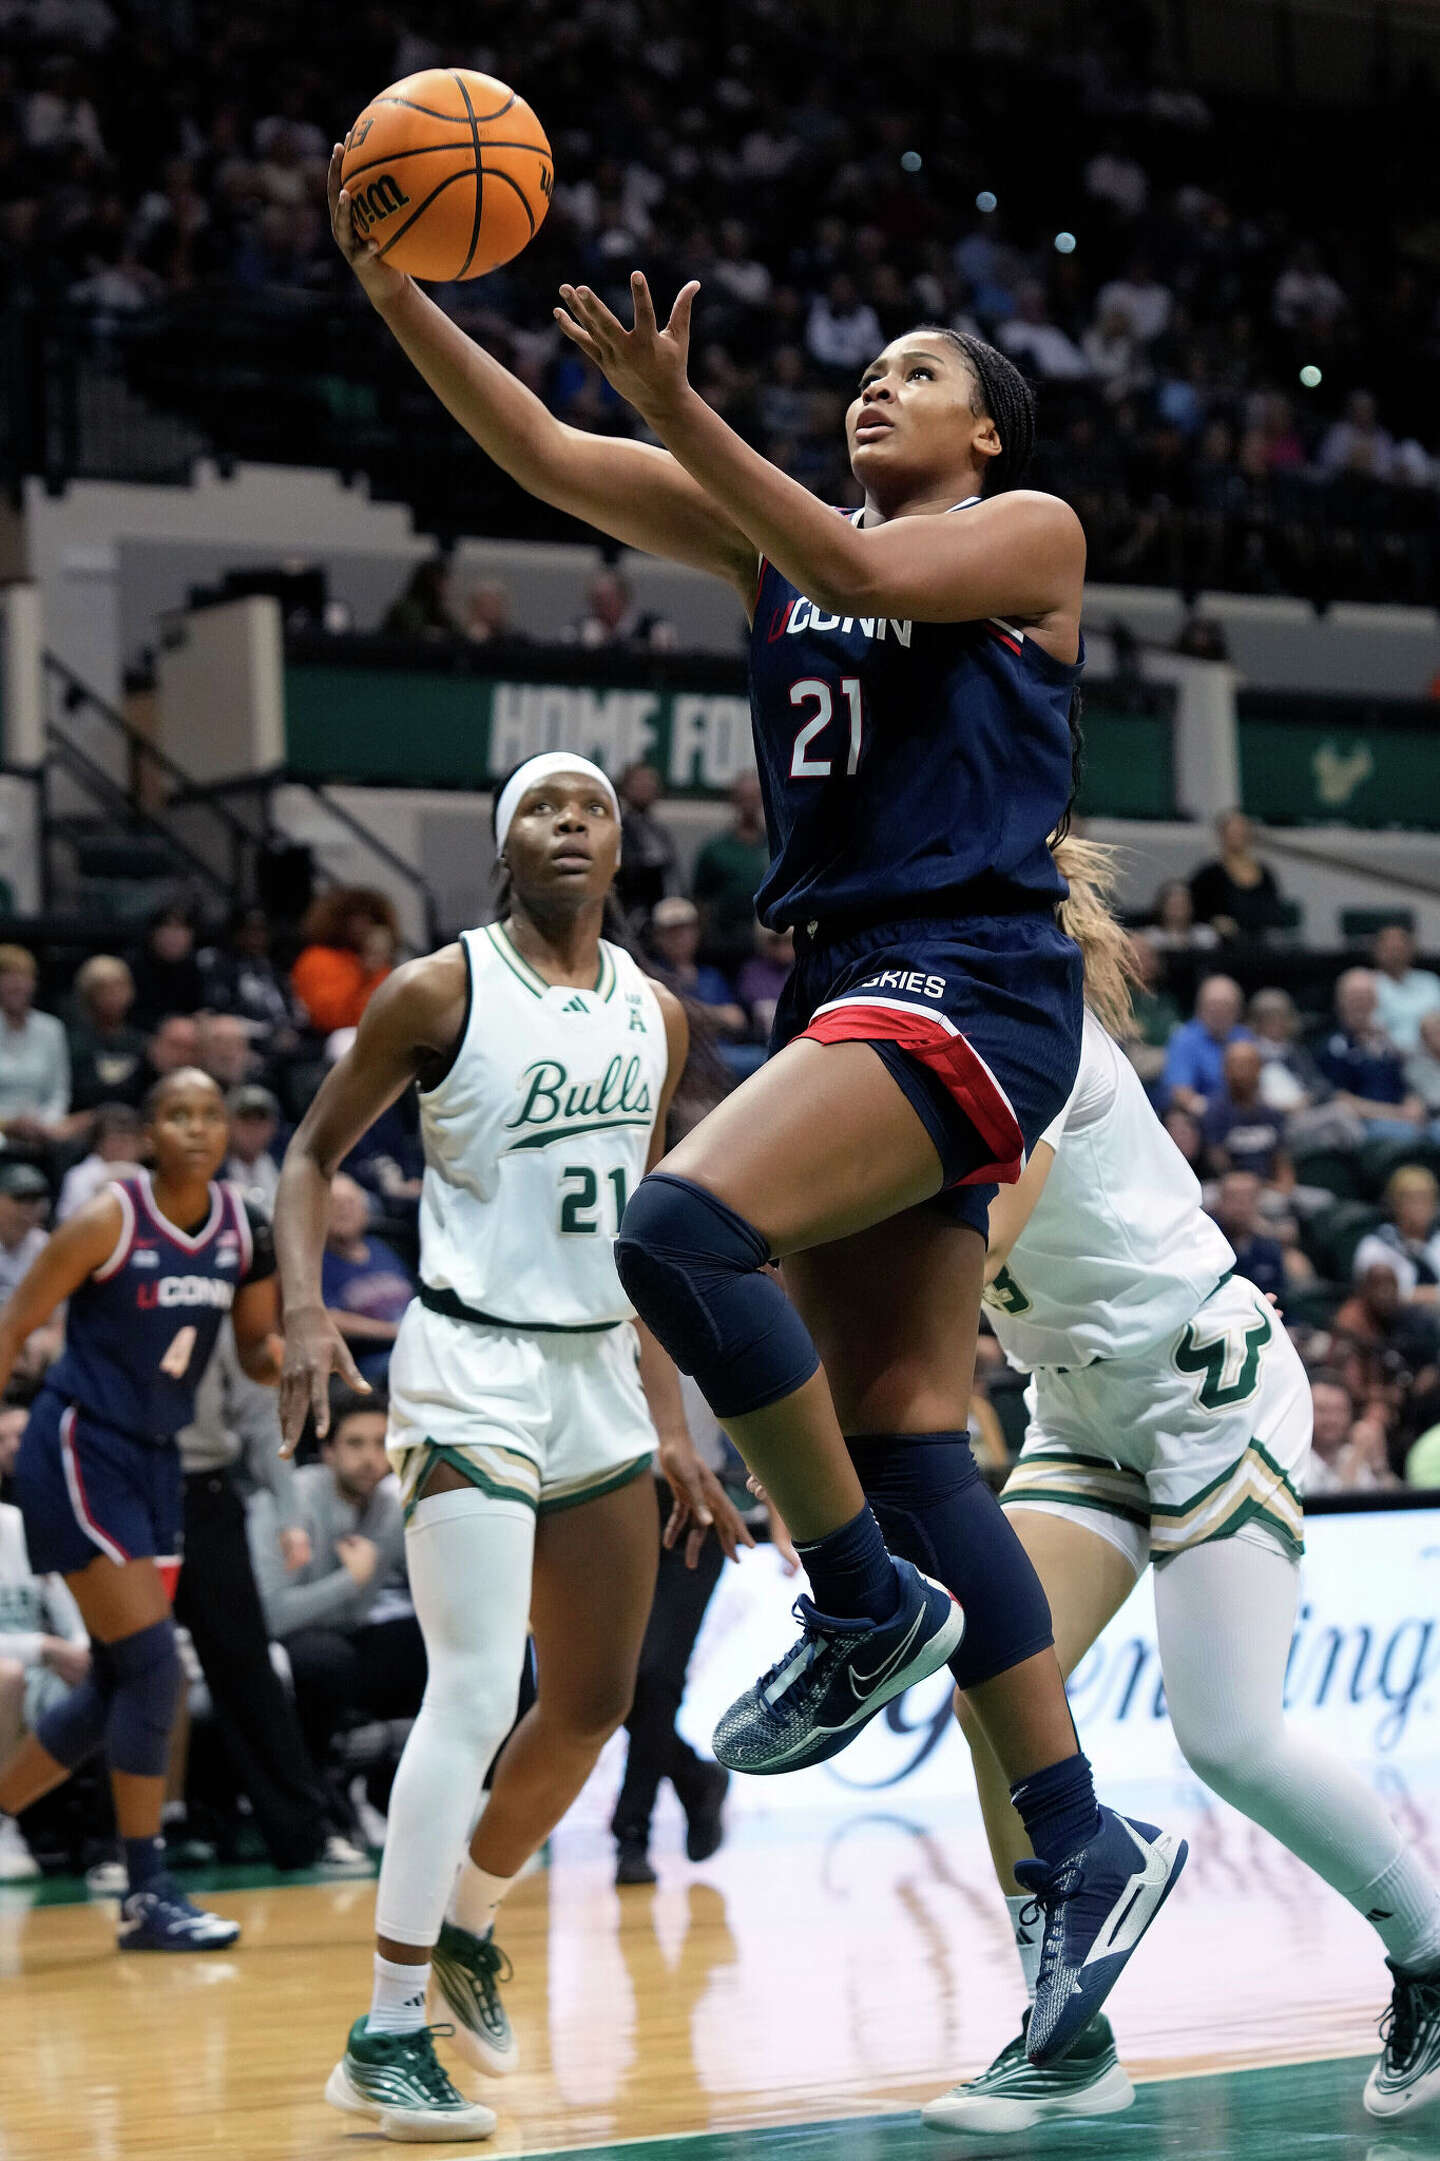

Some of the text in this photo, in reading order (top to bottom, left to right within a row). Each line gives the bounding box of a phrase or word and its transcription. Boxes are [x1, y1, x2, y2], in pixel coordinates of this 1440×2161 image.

[488, 682, 661, 783] HOME
[789, 675, 863, 780] 21
[504, 1053, 654, 1130] Bulls
[560, 1166, 628, 1234] 21
